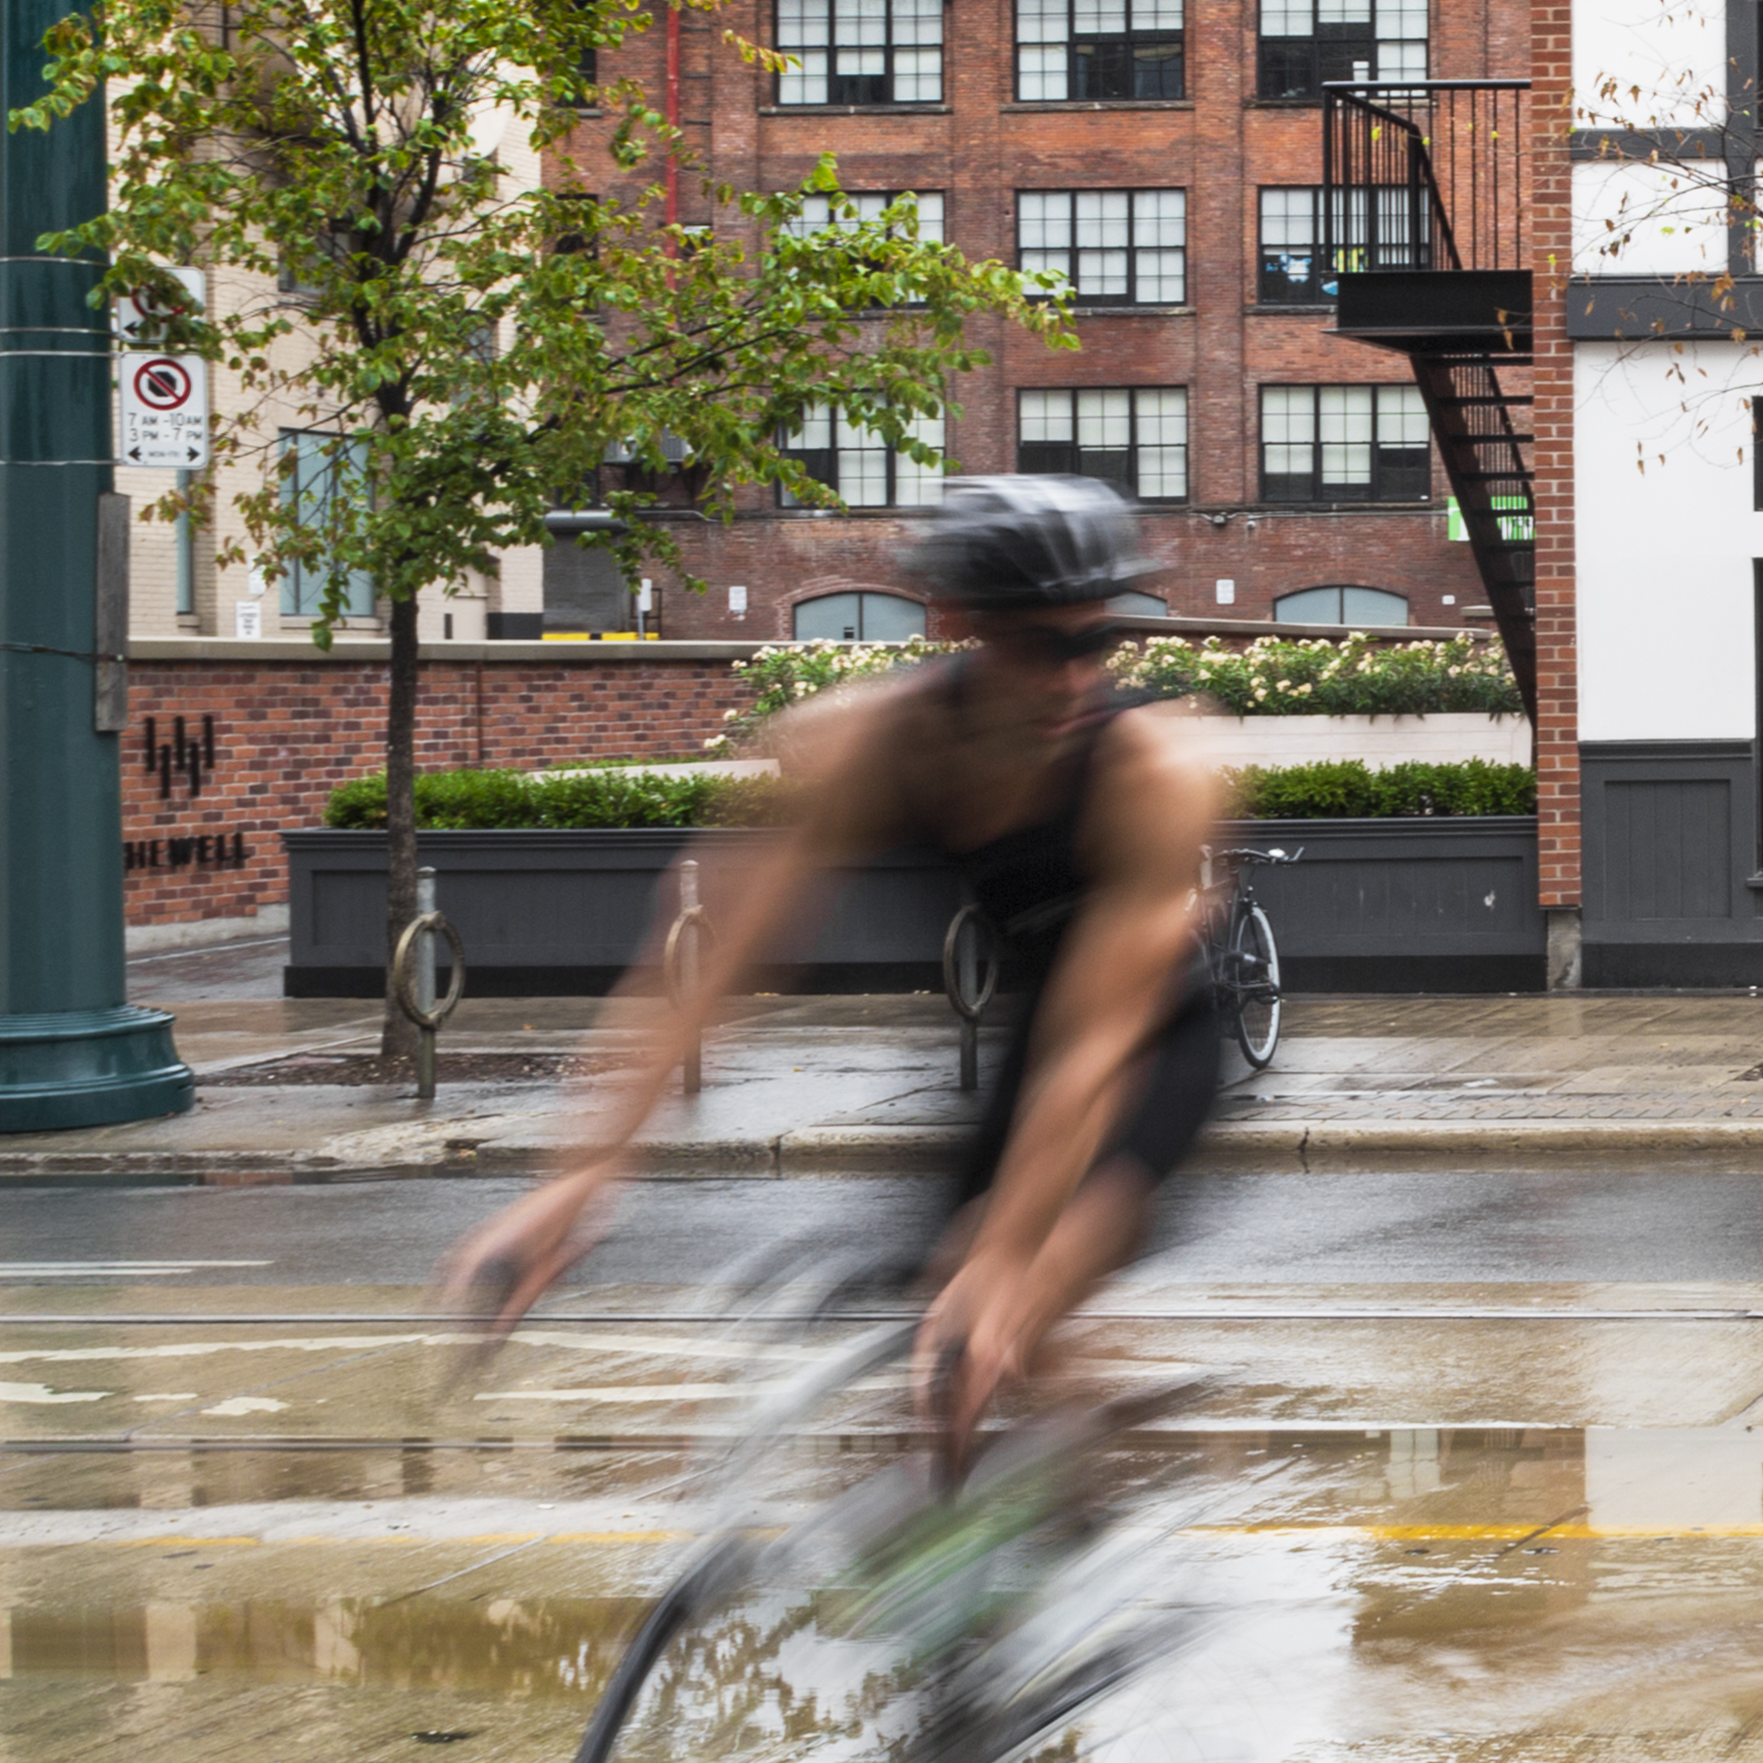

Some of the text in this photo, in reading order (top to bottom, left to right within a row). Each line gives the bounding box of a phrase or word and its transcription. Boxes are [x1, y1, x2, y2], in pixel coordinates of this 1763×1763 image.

[127, 412, 137, 426] 7
[142, 416, 158, 426] AM
[129, 428, 138, 442] 3
[142, 431, 158, 441] PM
[173, 428, 182, 441] 7
[186, 431, 203, 441] PM
[123, 833, 251, 870] HEWELL
